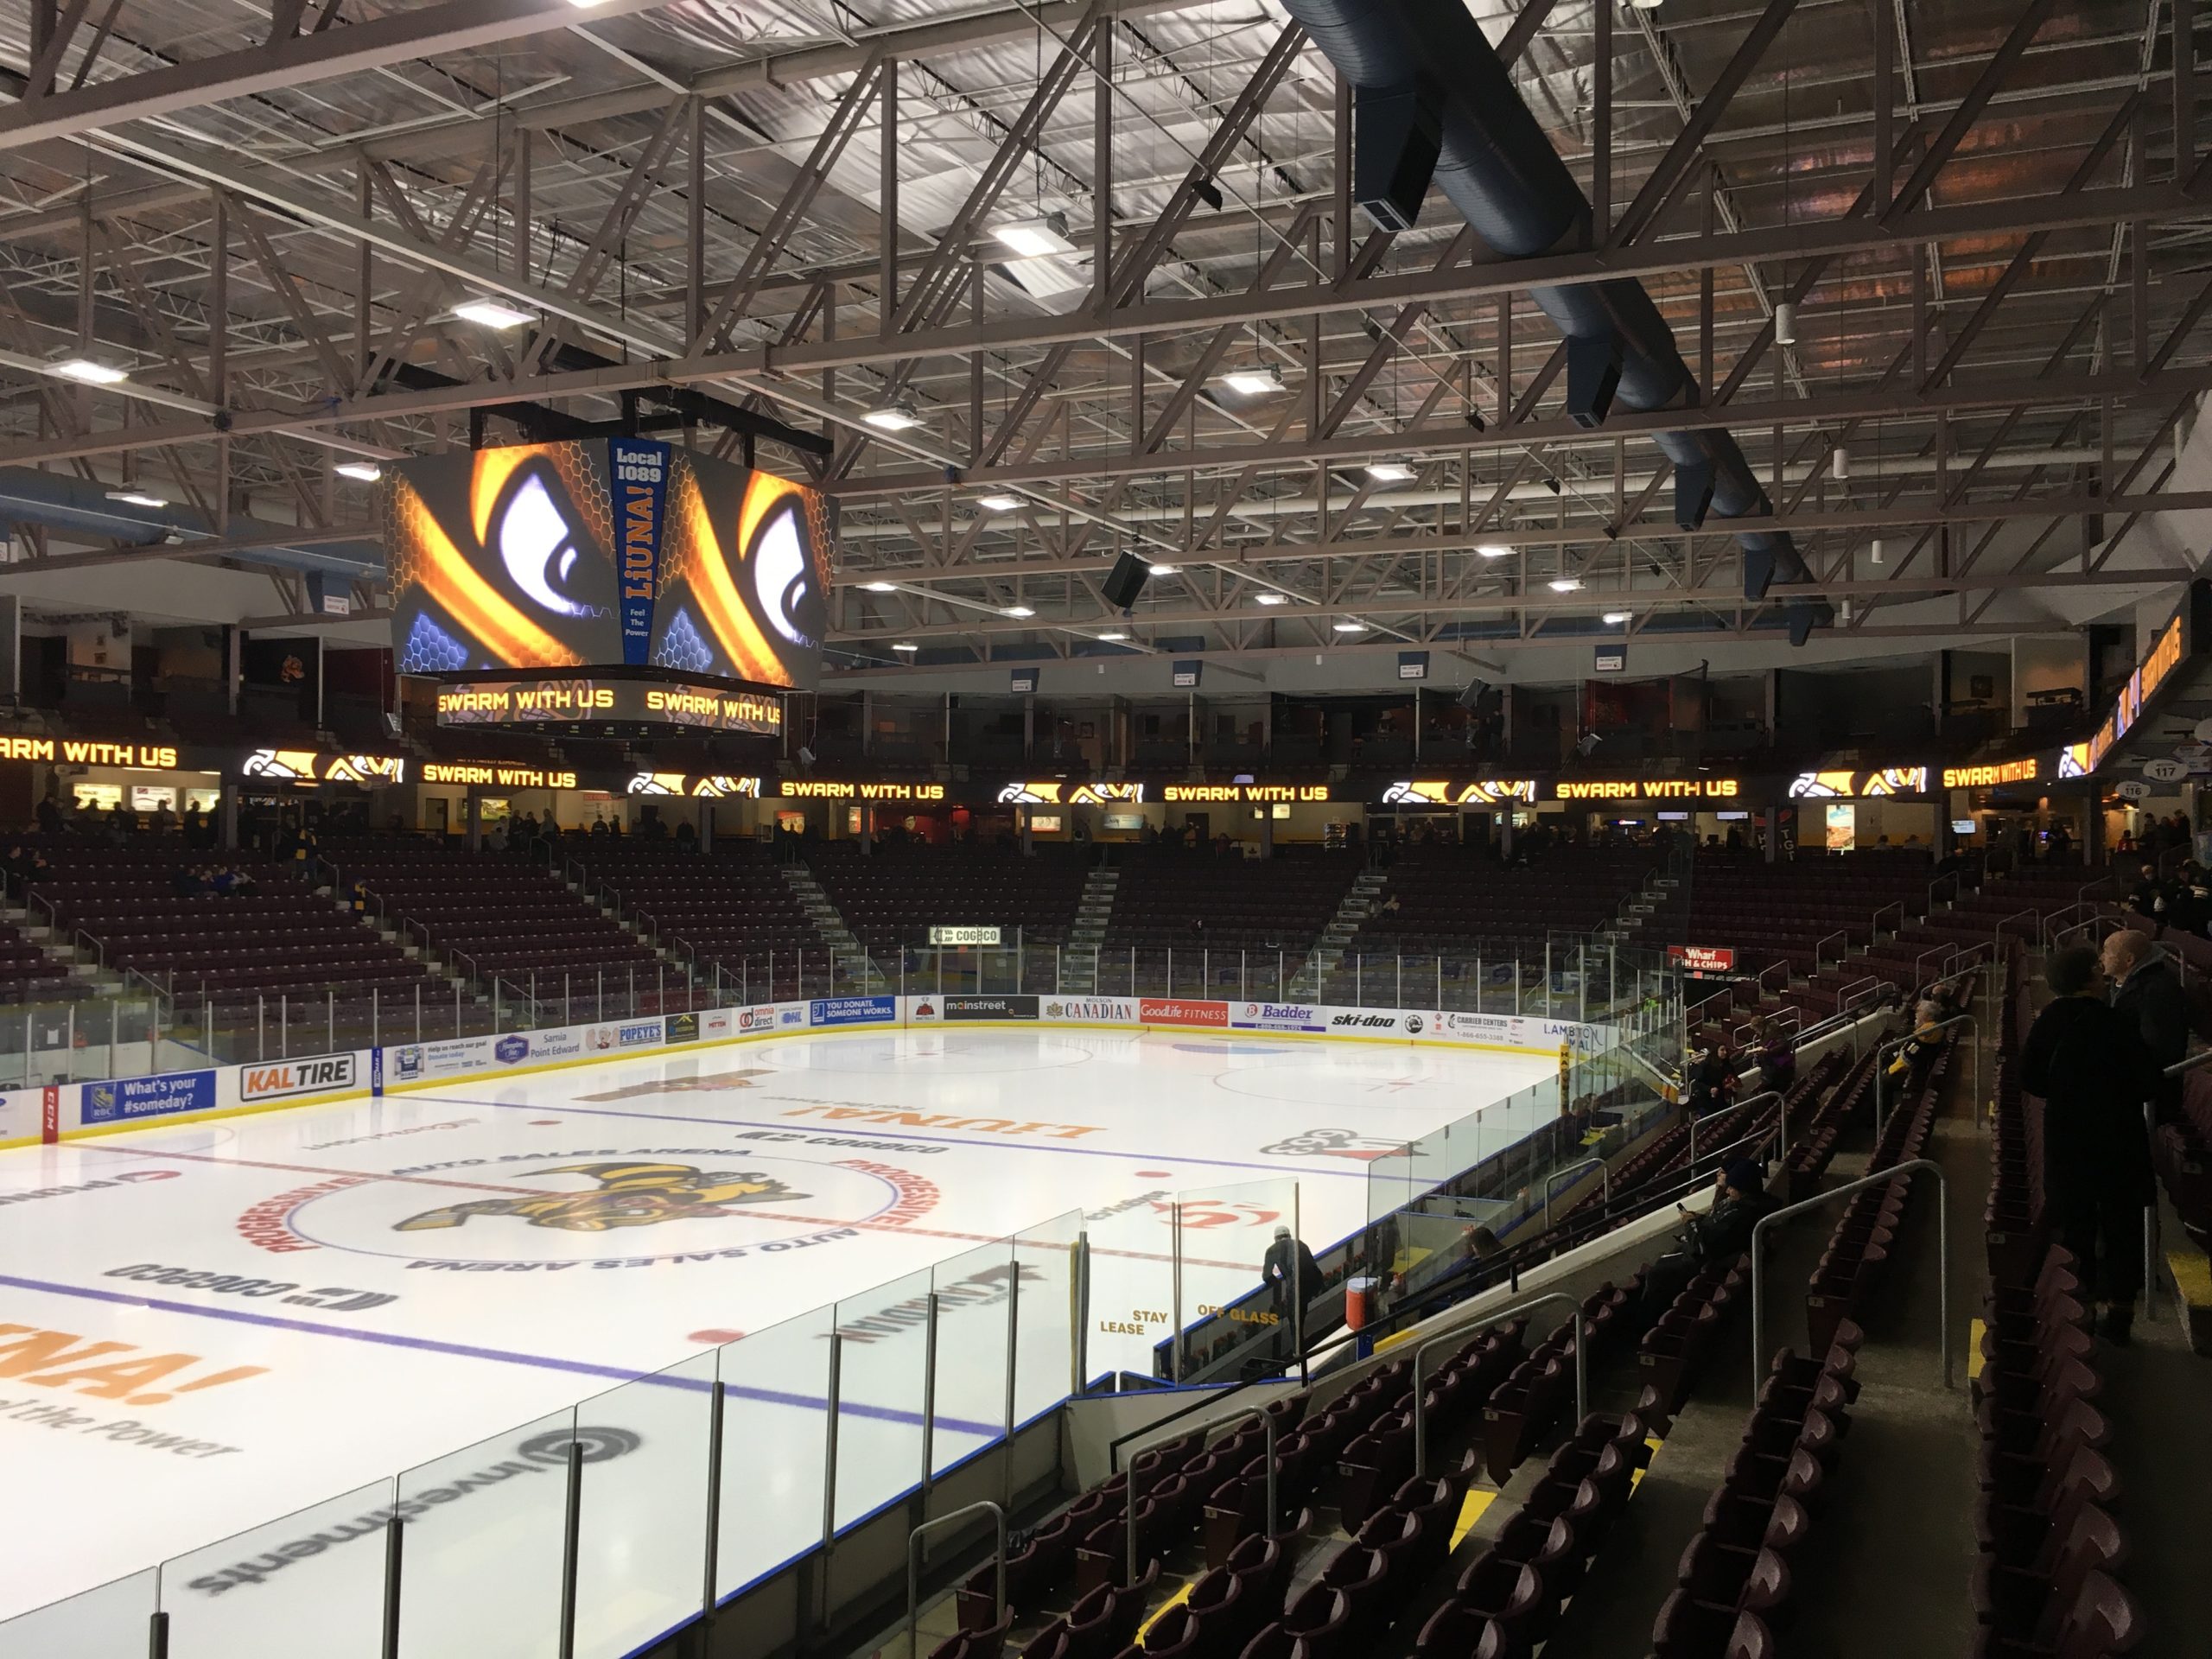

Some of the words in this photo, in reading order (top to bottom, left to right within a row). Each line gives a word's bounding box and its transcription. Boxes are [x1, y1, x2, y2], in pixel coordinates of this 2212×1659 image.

[616, 448, 663, 467] Local
[618, 465, 662, 483] 1089
[624, 486, 654, 600] LiUNA!
[630, 608, 645, 617] Feel
[438, 692, 509, 712] SWARM
[516, 690, 571, 709] WITH
[577, 690, 613, 708] US
[647, 691, 719, 715] SWARM
[723, 700, 762, 721] WITH
[767, 702, 780, 724] US
[63, 741, 133, 765] WITH
[141, 747, 177, 767] US
[423, 765, 493, 784] SWARM
[497, 769, 543, 786] WITH
[549, 772, 576, 788] US
[1943, 766, 1999, 787] SWARM
[2001, 762, 2022, 782] WITH
[2023, 759, 2037, 779] US
[2155, 767, 2176, 777] 117
[781, 782, 855, 798] SWARM
[860, 784, 910, 798] WITH
[916, 785, 944, 799] US
[1164, 786, 1239, 801] SWARM
[1244, 786, 1294, 801] WITH
[1300, 786, 1328, 800] US
[1556, 782, 1636, 798] SWARM
[1643, 781, 1700, 797] WITH
[1707, 780, 1738, 796] US
[1685, 948, 1717, 960] Wharf
[1700, 960, 1728, 969] CHIPS
[754, 1007, 774, 1016] omnia
[863, 1007, 893, 1015] WORKS.
[946, 1000, 1007, 1010] mainstreet
[1065, 1002, 1132, 1020] CANADIAN
[1141, 1004, 1182, 1017] GoodLife
[1184, 1009, 1227, 1020] FITNESS
[1262, 1005, 1313, 1019] Badder
[754, 1016, 773, 1027] direct
[1332, 1014, 1395, 1027] ski-doo
[1457, 1015, 1482, 1026] CARRIER
[1483, 1018, 1508, 1027] CENTERS
[620, 1024, 662, 1041] POPEYE'S
[531, 1046, 551, 1058] Point
[552, 1044, 580, 1055] Edward
[247, 1067, 295, 1093] KAL
[296, 1059, 350, 1086] TIRE
[124, 1079, 167, 1096] What's
[169, 1077, 196, 1092] your
[124, 1093, 194, 1114] #someday?
[93, 1108, 112, 1117] RBC
[236, 1176, 370, 1253] PROGRESSIVE
[391, 1158, 486, 1175] AUTO
[498, 1148, 618, 1162] SALES
[626, 1147, 753, 1156] ARENA
[831, 1159, 941, 1226] PROGRESSIVE
[760, 1228, 861, 1252] AUTO
[405, 1260, 579, 1273] ARENA
[592, 1248, 749, 1271] SALES
[1133, 1309, 1168, 1324] STAY
[1198, 1304, 1224, 1319] OFF
[1229, 1307, 1279, 1325] GLASS
[1100, 1321, 1145, 1336] LEASE
[8, 1405, 96, 1429] the
[81, 1419, 244, 1459] Power
